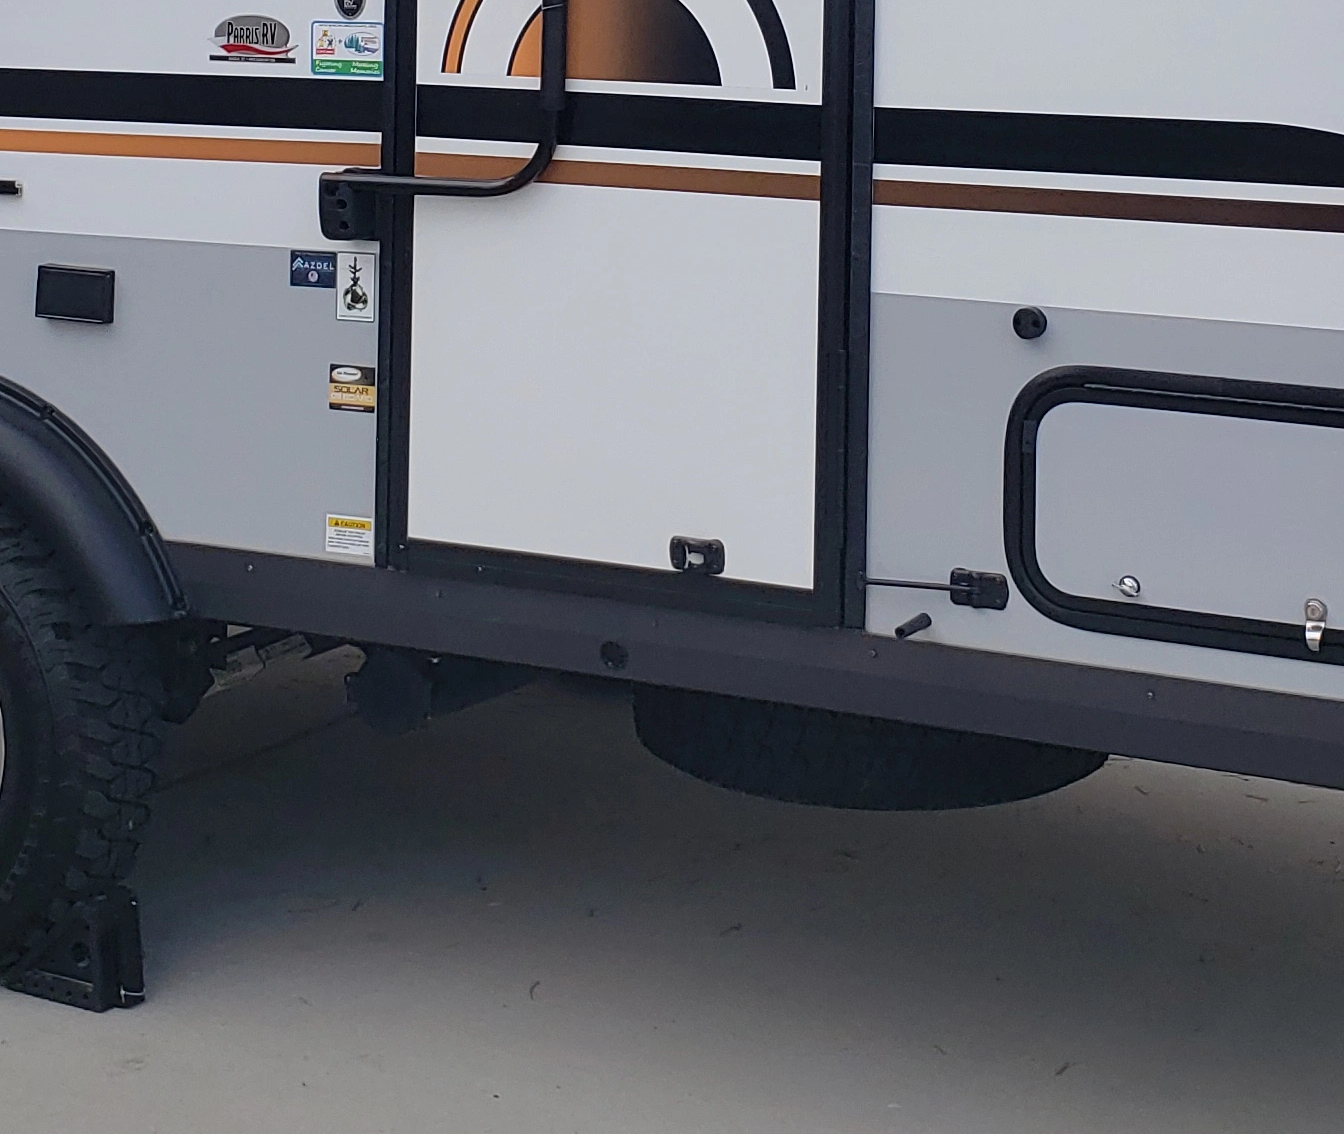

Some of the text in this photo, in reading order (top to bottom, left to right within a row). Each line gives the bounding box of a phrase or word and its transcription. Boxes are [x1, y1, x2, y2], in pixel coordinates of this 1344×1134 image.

[227, 21, 277, 45] PARRIS RV
[304, 261, 334, 270] AZDEL
[334, 385, 368, 395] SOLAR
